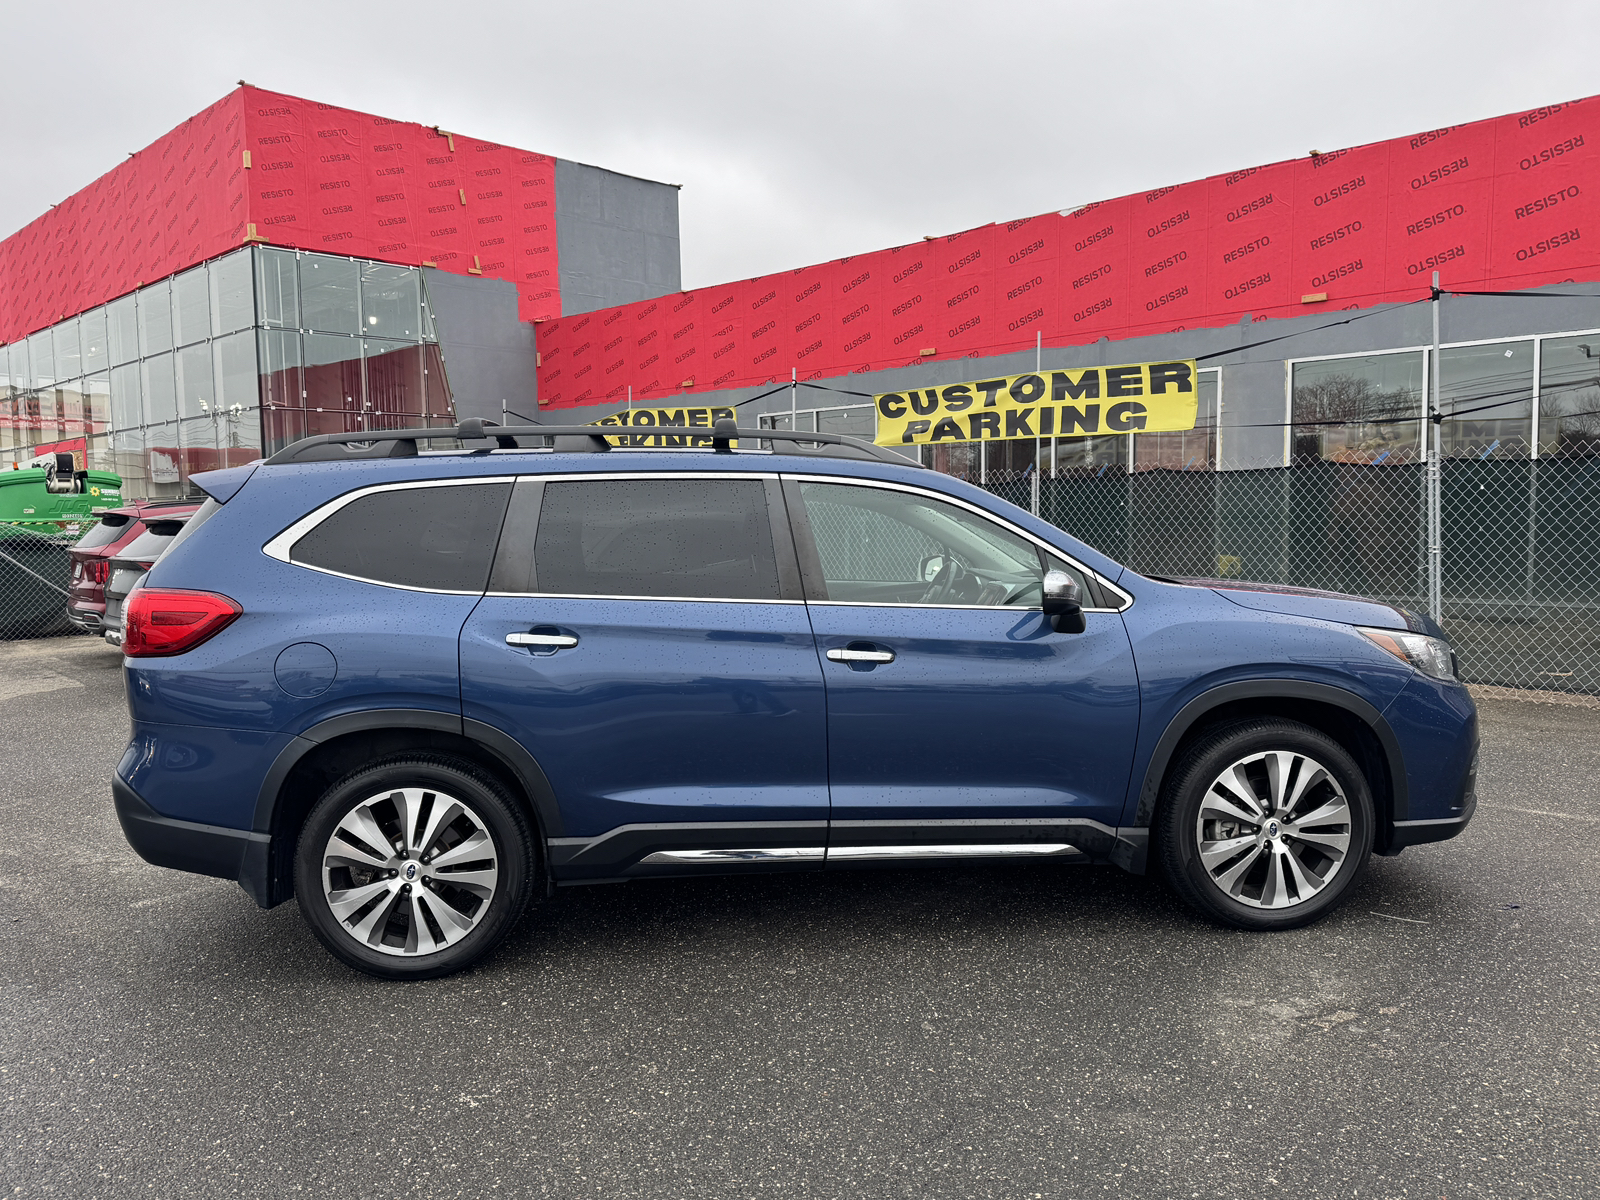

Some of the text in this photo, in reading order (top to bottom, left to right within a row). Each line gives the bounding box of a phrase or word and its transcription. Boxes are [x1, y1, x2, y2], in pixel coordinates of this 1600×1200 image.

[258, 107, 291, 116] RESISTO
[257, 135, 290, 144] RESISTO
[317, 129, 347, 137] RESISTO
[373, 143, 402, 152] RESISTO
[475, 143, 501, 153] RESISTO
[1519, 134, 1584, 170] RESISTO
[260, 161, 293, 170] RESISTO
[319, 153, 350, 162] RESISTO
[425, 155, 453, 164] RESISTO
[521, 155, 546, 163] RESISTO
[376, 167, 404, 176] RESISTO
[475, 167, 500, 176] RESISTO
[1411, 156, 1468, 190] RESISTO
[319, 180, 350, 190] RESISTO
[428, 179, 455, 188] RESISTO
[521, 178, 545, 187] RESISTO
[1313, 175, 1366, 206] RESISTO
[260, 188, 292, 199] RESISTO
[375, 192, 404, 202] RESISTO
[477, 190, 502, 199] RESISTO
[322, 205, 353, 215] RESISTO
[427, 204, 455, 214] RESISTO
[523, 200, 547, 209] RESISTO
[1226, 193, 1273, 222] RESISTO
[1514, 185, 1582, 220] RESISTO
[263, 214, 296, 225] RESISTO
[377, 216, 406, 226] RESISTO
[477, 215, 502, 224] RESISTO
[523, 223, 547, 233] RESISTO
[1147, 209, 1190, 238] RESISTO
[1406, 204, 1466, 236] RESISTO
[322, 231, 352, 242] RESISTO
[430, 227, 457, 237] RESISTO
[1074, 225, 1114, 251] RESISTO
[1309, 220, 1362, 250] RESISTO
[378, 242, 406, 253] RESISTO
[479, 237, 504, 247] RESISTO
[525, 246, 549, 255] RESISTO
[1223, 235, 1270, 264] RESISTO
[1515, 227, 1580, 261] RESISTO
[430, 252, 457, 262] RESISTO
[1008, 238, 1044, 264] RESISTO
[1405, 244, 1465, 275] RESISTO
[948, 249, 980, 273] RESISTO
[1144, 250, 1187, 277] RESISTO
[525, 269, 549, 279] RESISTO
[893, 260, 923, 283] RESISTO
[1071, 264, 1111, 290] RESISTO
[1311, 259, 1363, 288] RESISTO
[842, 271, 870, 293] RESISTO
[1006, 274, 1043, 300] RESISTO
[1224, 271, 1271, 299] RESISTO
[527, 291, 551, 301] RESISTO
[752, 290, 776, 310] RESISTO
[795, 281, 821, 302] RESISTO
[946, 285, 979, 308] RESISTO
[1145, 285, 1188, 311] RESISTO
[637, 303, 657, 320] RESISTO
[673, 294, 694, 312] RESISTO
[711, 295, 734, 314] RESISTO
[891, 294, 922, 316] RESISTO
[1073, 297, 1112, 322] RESISTO
[603, 311, 622, 326] RESISTO
[795, 312, 820, 332] RESISTO
[841, 303, 869, 324] RESISTO
[1008, 307, 1044, 331] RESISTO
[543, 323, 560, 339] RESISTO
[573, 317, 590, 333] RESISTO
[673, 322, 694, 340] RESISTO
[751, 320, 775, 339] RESISTO
[948, 315, 980, 338] RESISTO
[637, 329, 657, 346] RESISTO
[843, 331, 871, 352] RESISTO
[893, 323, 923, 345] RESISTO
[573, 341, 591, 357] RESISTO
[604, 335, 623, 351] RESISTO
[713, 341, 735, 359] RESISTO
[797, 339, 822, 359] RESISTO
[543, 347, 560, 362] RESISTO
[639, 353, 658, 369] RESISTO
[675, 347, 695, 364] RESISTO
[753, 346, 777, 364] RESISTO
[574, 365, 592, 379] RESISTO
[605, 358, 624, 374] RESISTO
[545, 369, 561, 384] RESISTO
[712, 369, 734, 386] RESISTO
[605, 384, 624, 398] RESISTO
[639, 379, 658, 394] RESISTO
[878, 363, 1193, 419] CUSTOMER
[574, 389, 592, 403] RESISTO
[902, 401, 1148, 443] PARKING
